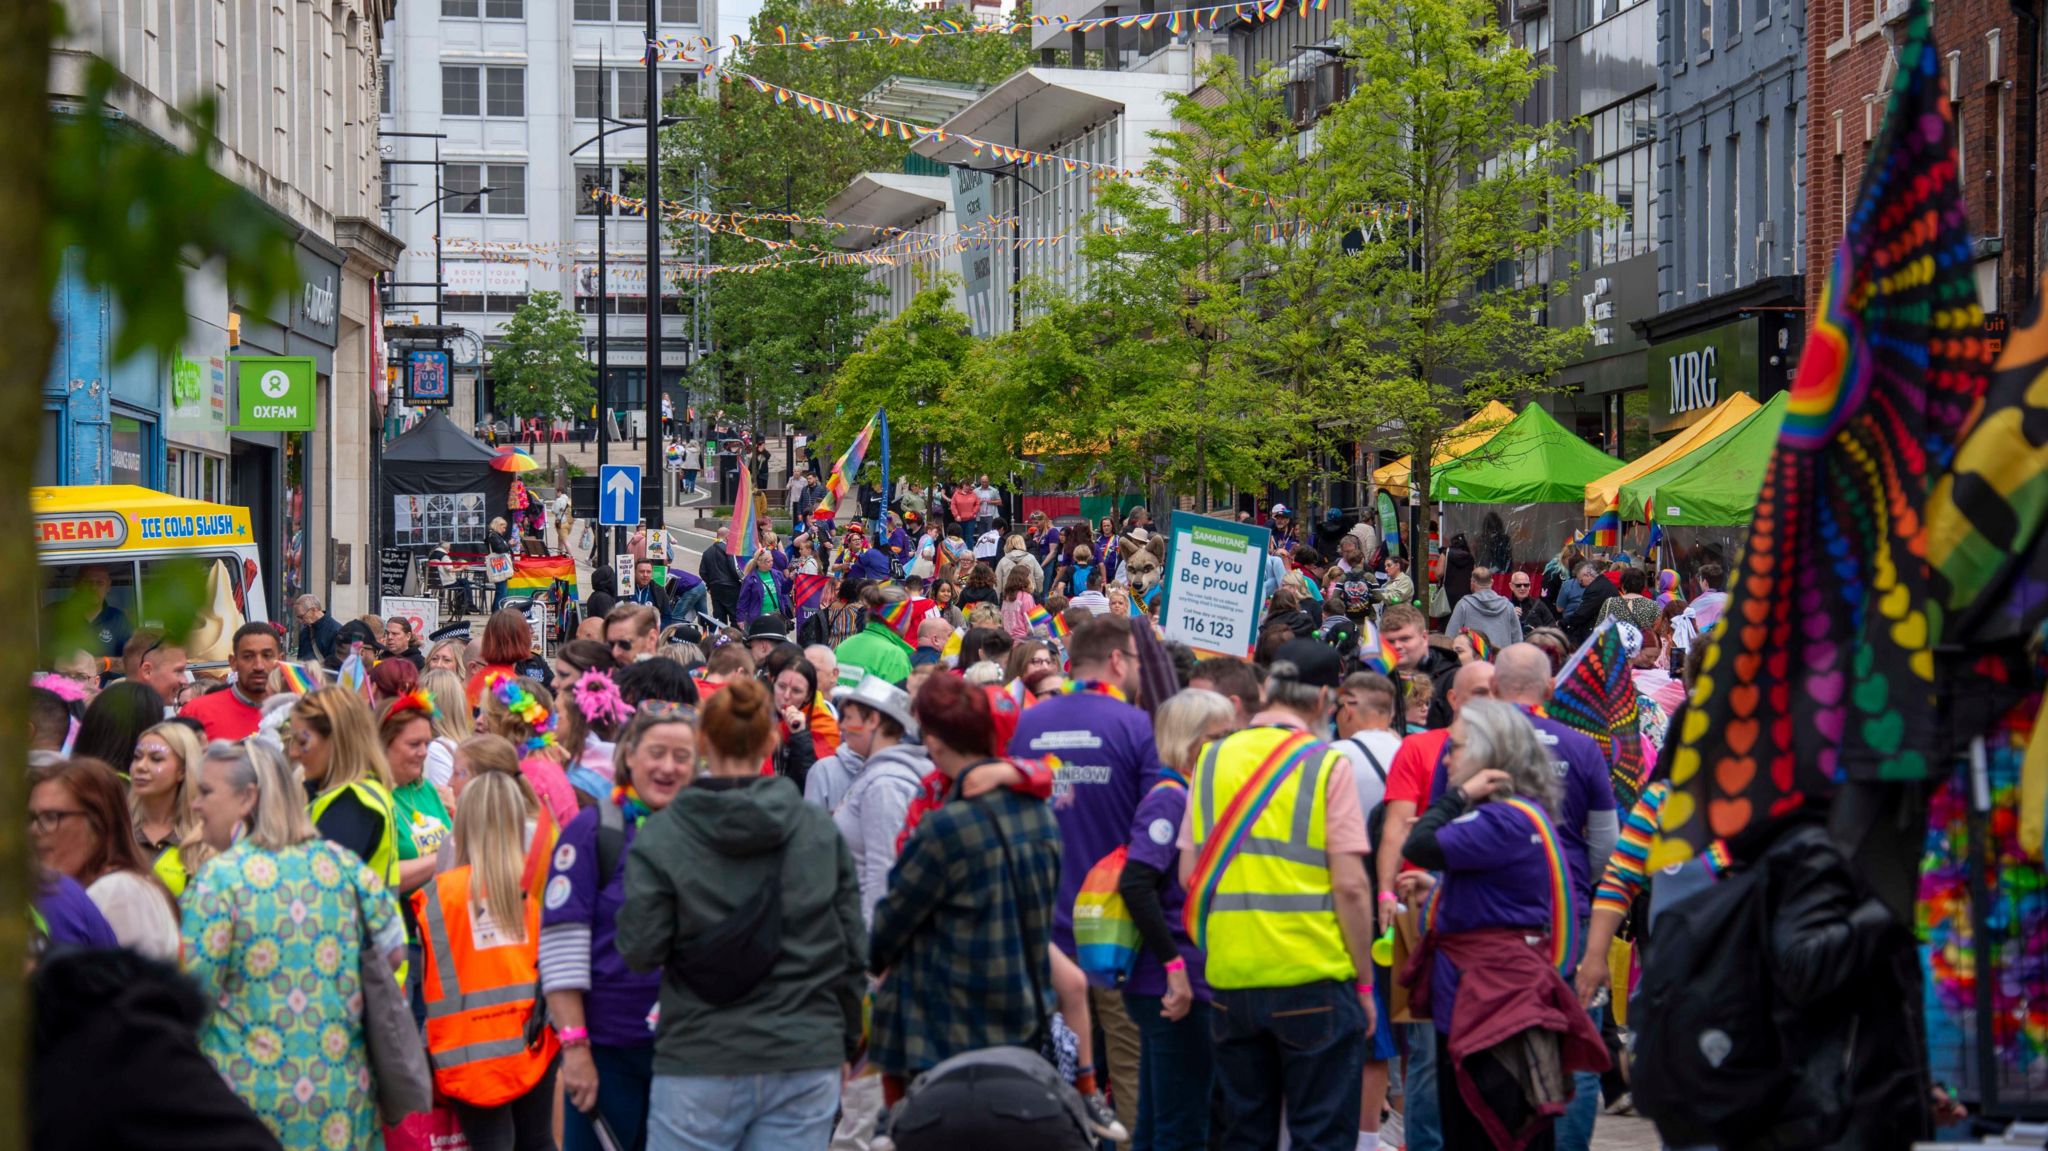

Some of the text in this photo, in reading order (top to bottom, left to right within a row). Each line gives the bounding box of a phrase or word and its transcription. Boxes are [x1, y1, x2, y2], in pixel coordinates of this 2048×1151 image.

[1669, 345, 1717, 415] MRG
[253, 405, 297, 418] OXFAM
[141, 515, 233, 538] ICE COLD SLUSH
[1193, 530, 1247, 549] SAMARITANS
[1191, 551, 1243, 575] Be you
[1181, 568, 1248, 594] Be proud
[1182, 615, 1234, 639] 116 123
